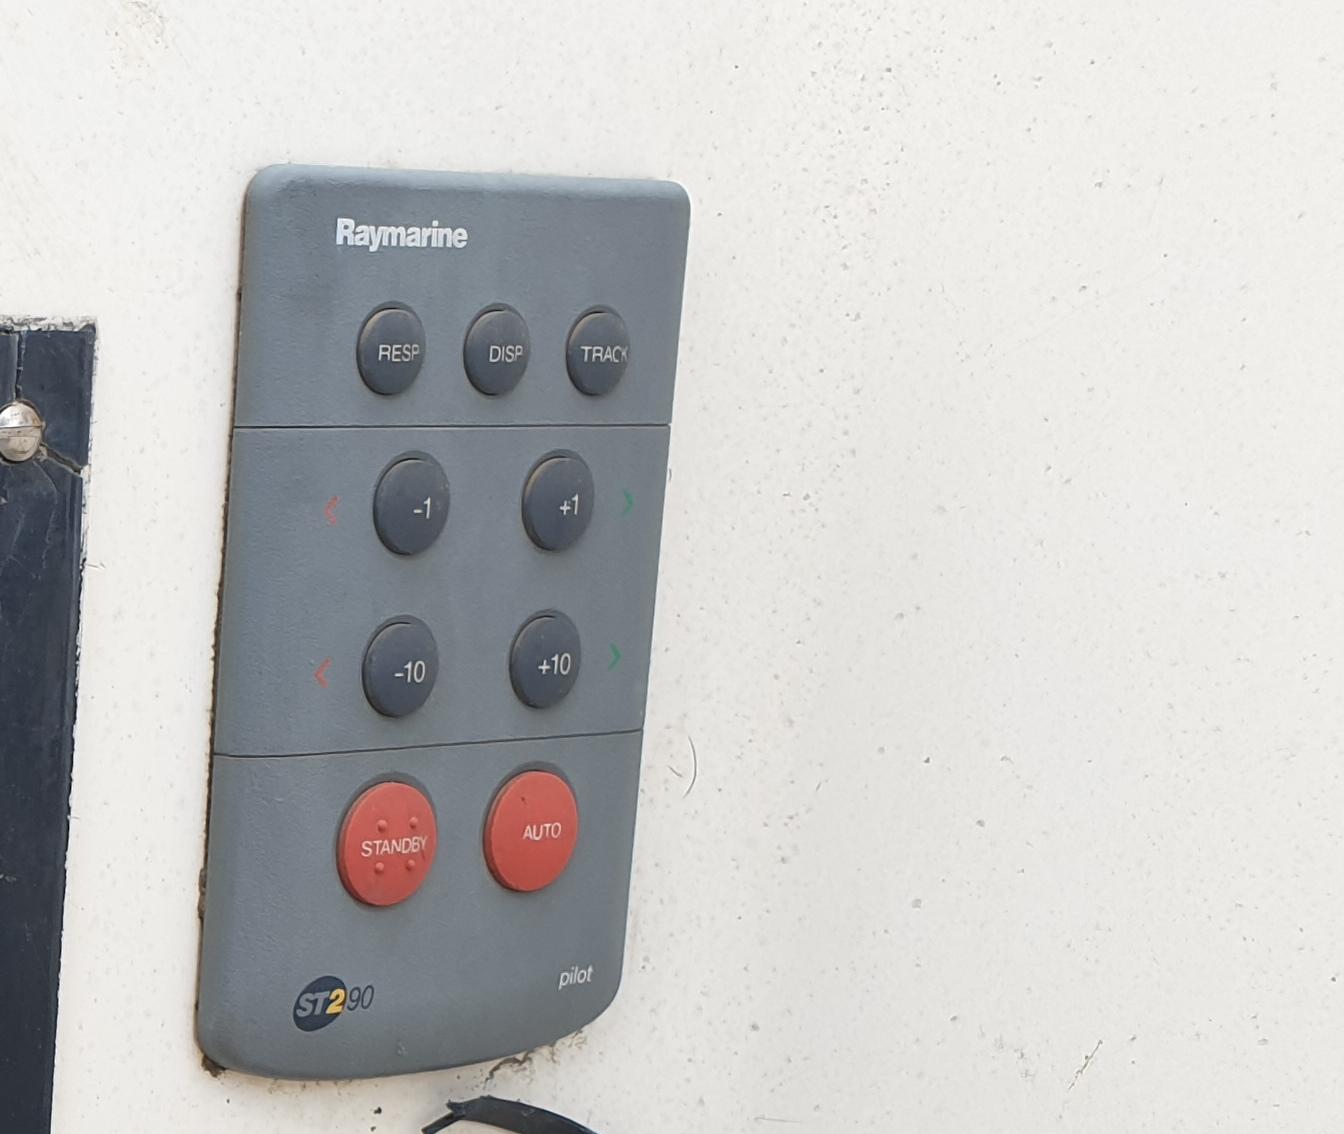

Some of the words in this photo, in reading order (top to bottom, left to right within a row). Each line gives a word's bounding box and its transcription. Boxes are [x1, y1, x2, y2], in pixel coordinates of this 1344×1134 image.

[335, 217, 469, 252] Raymarine
[377, 343, 420, 363] RESP
[488, 345, 524, 363] DISP
[580, 345, 629, 363] TRACK
[413, 496, 431, 519] -1
[559, 493, 580, 516] +1
[393, 660, 426, 684] -10
[537, 652, 572, 676] +10
[522, 822, 562, 841] AUTO
[360, 835, 428, 857] STANDBY
[557, 964, 594, 991] pilot
